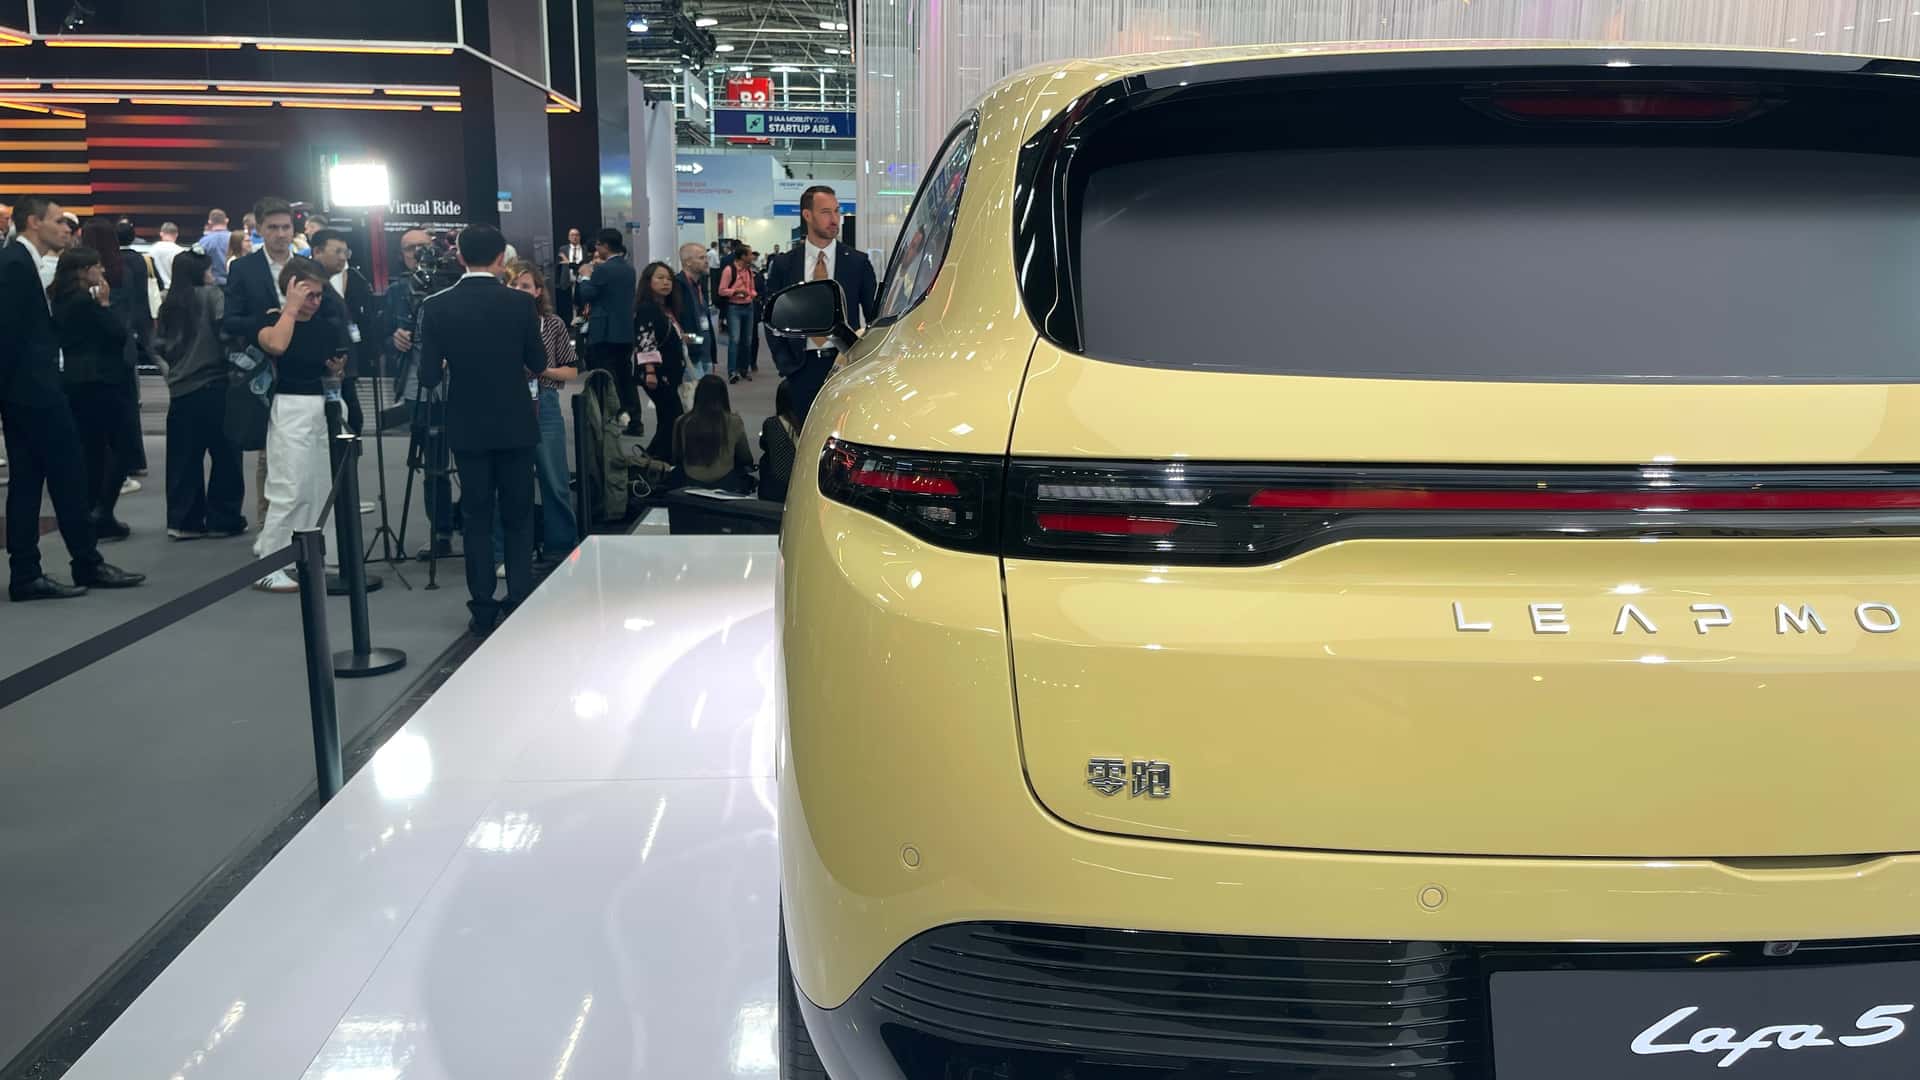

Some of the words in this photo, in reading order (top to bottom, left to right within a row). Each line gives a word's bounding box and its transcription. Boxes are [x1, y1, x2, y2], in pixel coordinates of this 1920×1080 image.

[768, 124, 810, 133] STARTUP
[812, 125, 837, 133] AREA
[388, 200, 430, 215] Virtual
[433, 200, 461, 215] Ride
[1451, 601, 1901, 635] LEAPMO
[1087, 757, 1171, 798] 零跑
[1630, 1006, 1835, 1068] Lafa
[1838, 1004, 1915, 1047] 5
